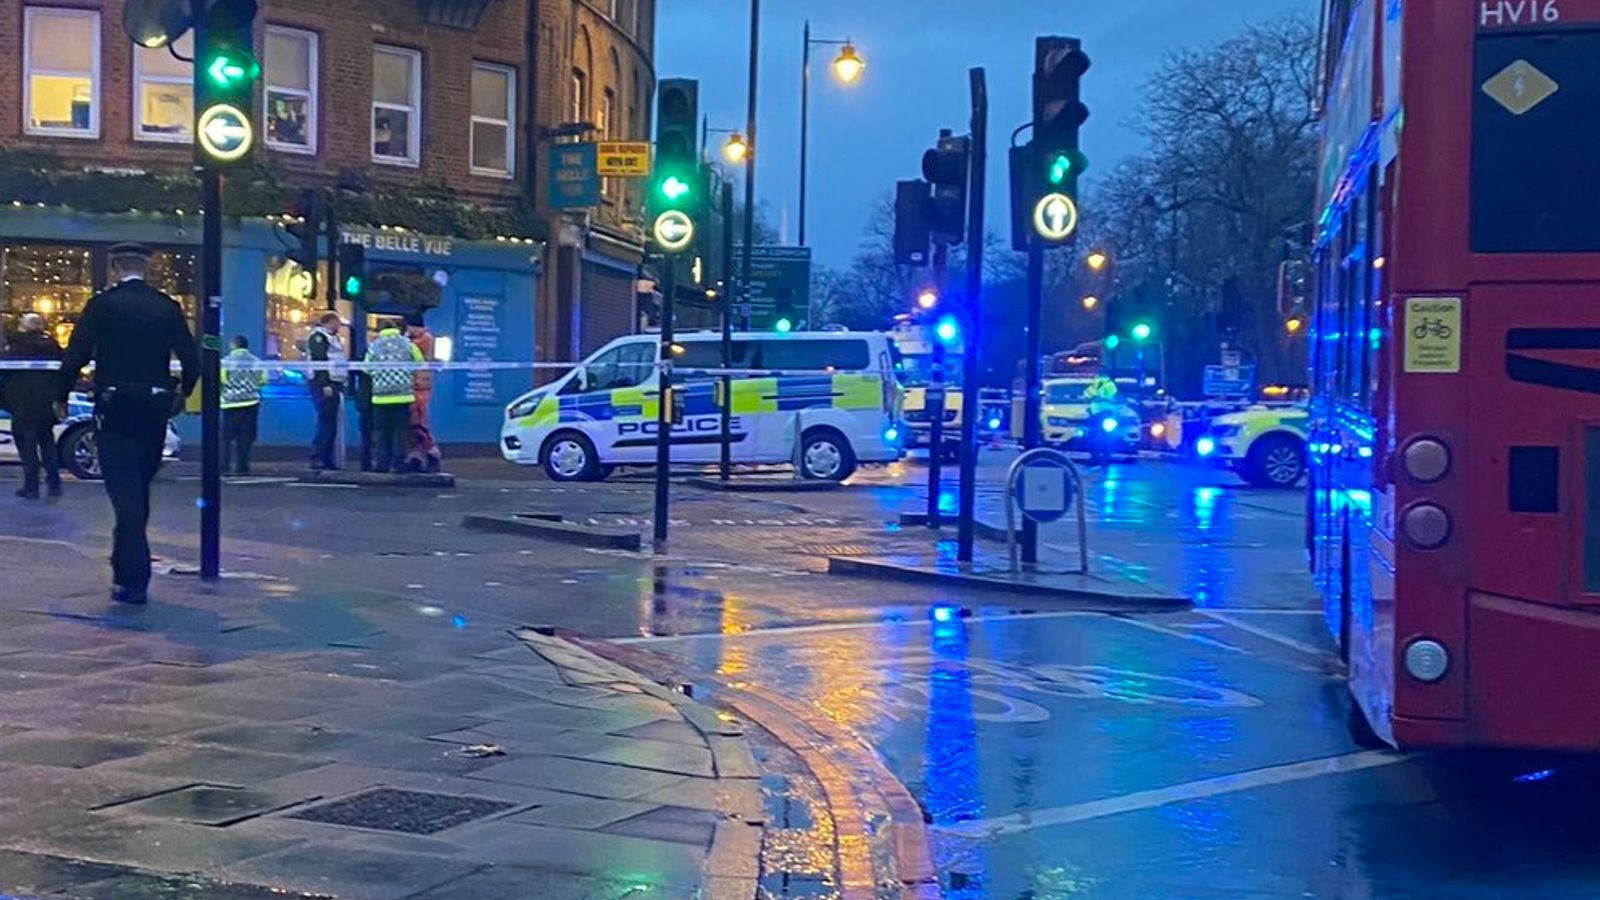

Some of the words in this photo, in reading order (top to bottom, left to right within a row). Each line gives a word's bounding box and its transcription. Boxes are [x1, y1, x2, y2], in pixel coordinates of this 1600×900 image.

[1481, 0, 1558, 25] HV16
[341, 231, 371, 249] THE
[375, 235, 418, 253] BELLE
[424, 240, 452, 256] VUE
